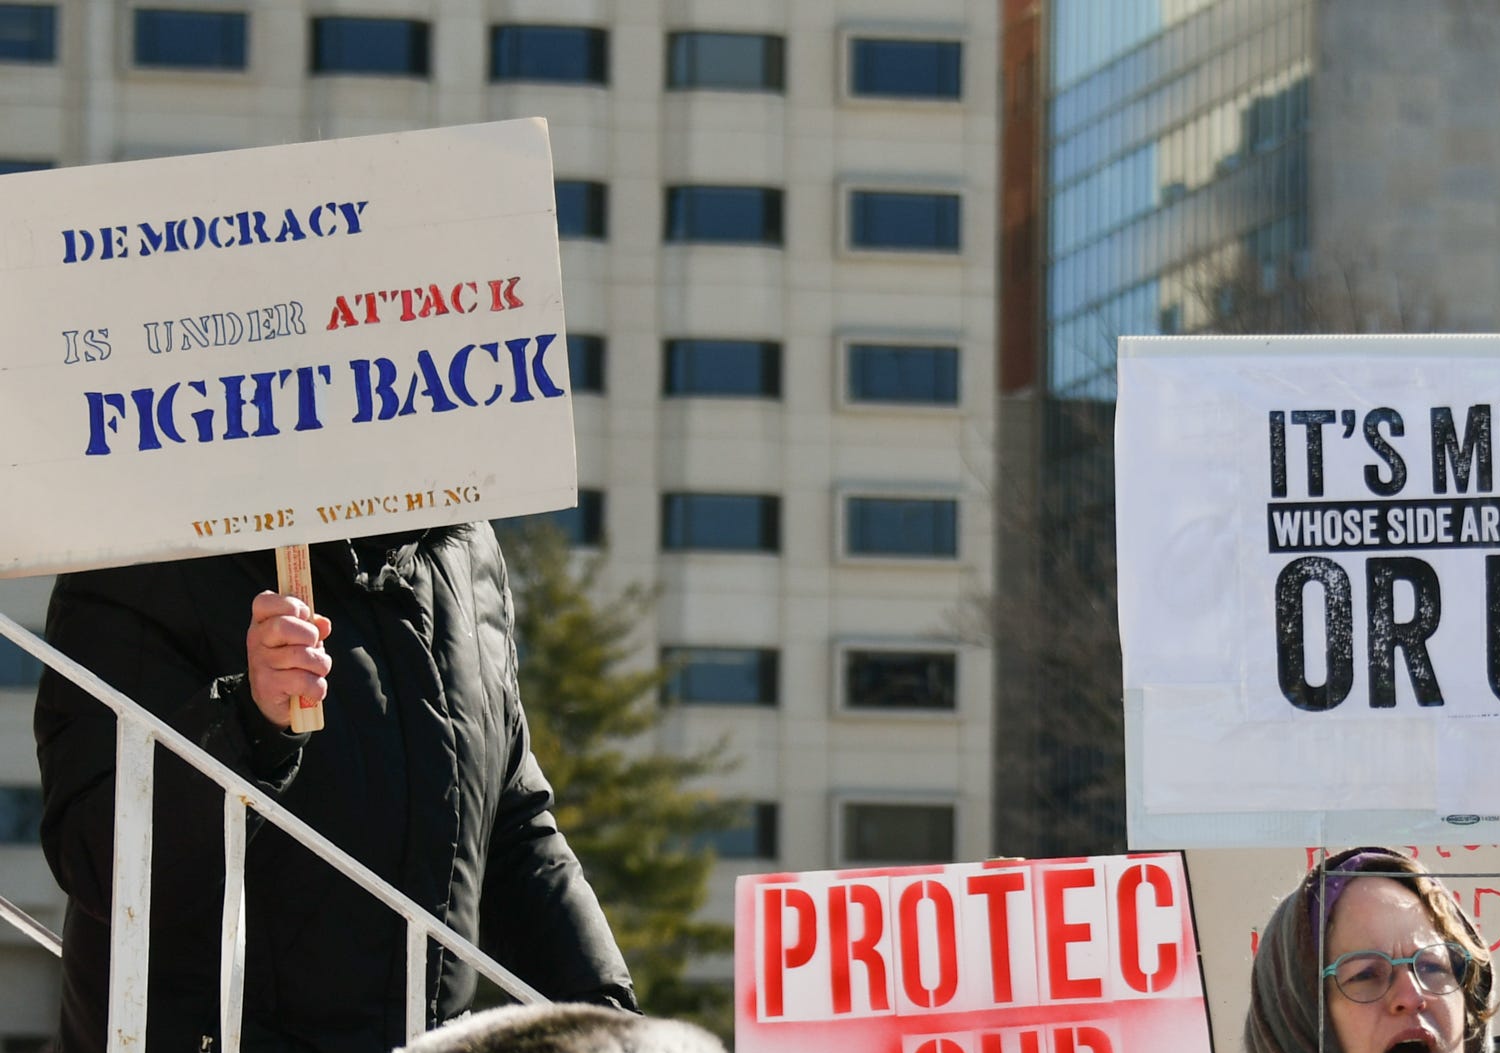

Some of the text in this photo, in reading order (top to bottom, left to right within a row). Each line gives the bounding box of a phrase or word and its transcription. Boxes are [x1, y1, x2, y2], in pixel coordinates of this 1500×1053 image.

[62, 201, 369, 263] DEMOCRACY
[63, 276, 524, 364] IS UNDER ATTACK
[85, 334, 565, 455] FIGHT BACK
[1269, 407, 1407, 498] IT'S
[192, 484, 481, 538] WE'RE WATCHING
[1272, 508, 1380, 547] WHOSE
[1387, 506, 1453, 544] SIDE
[1275, 556, 1444, 712] OR
[763, 863, 1177, 1017] PROTEC
